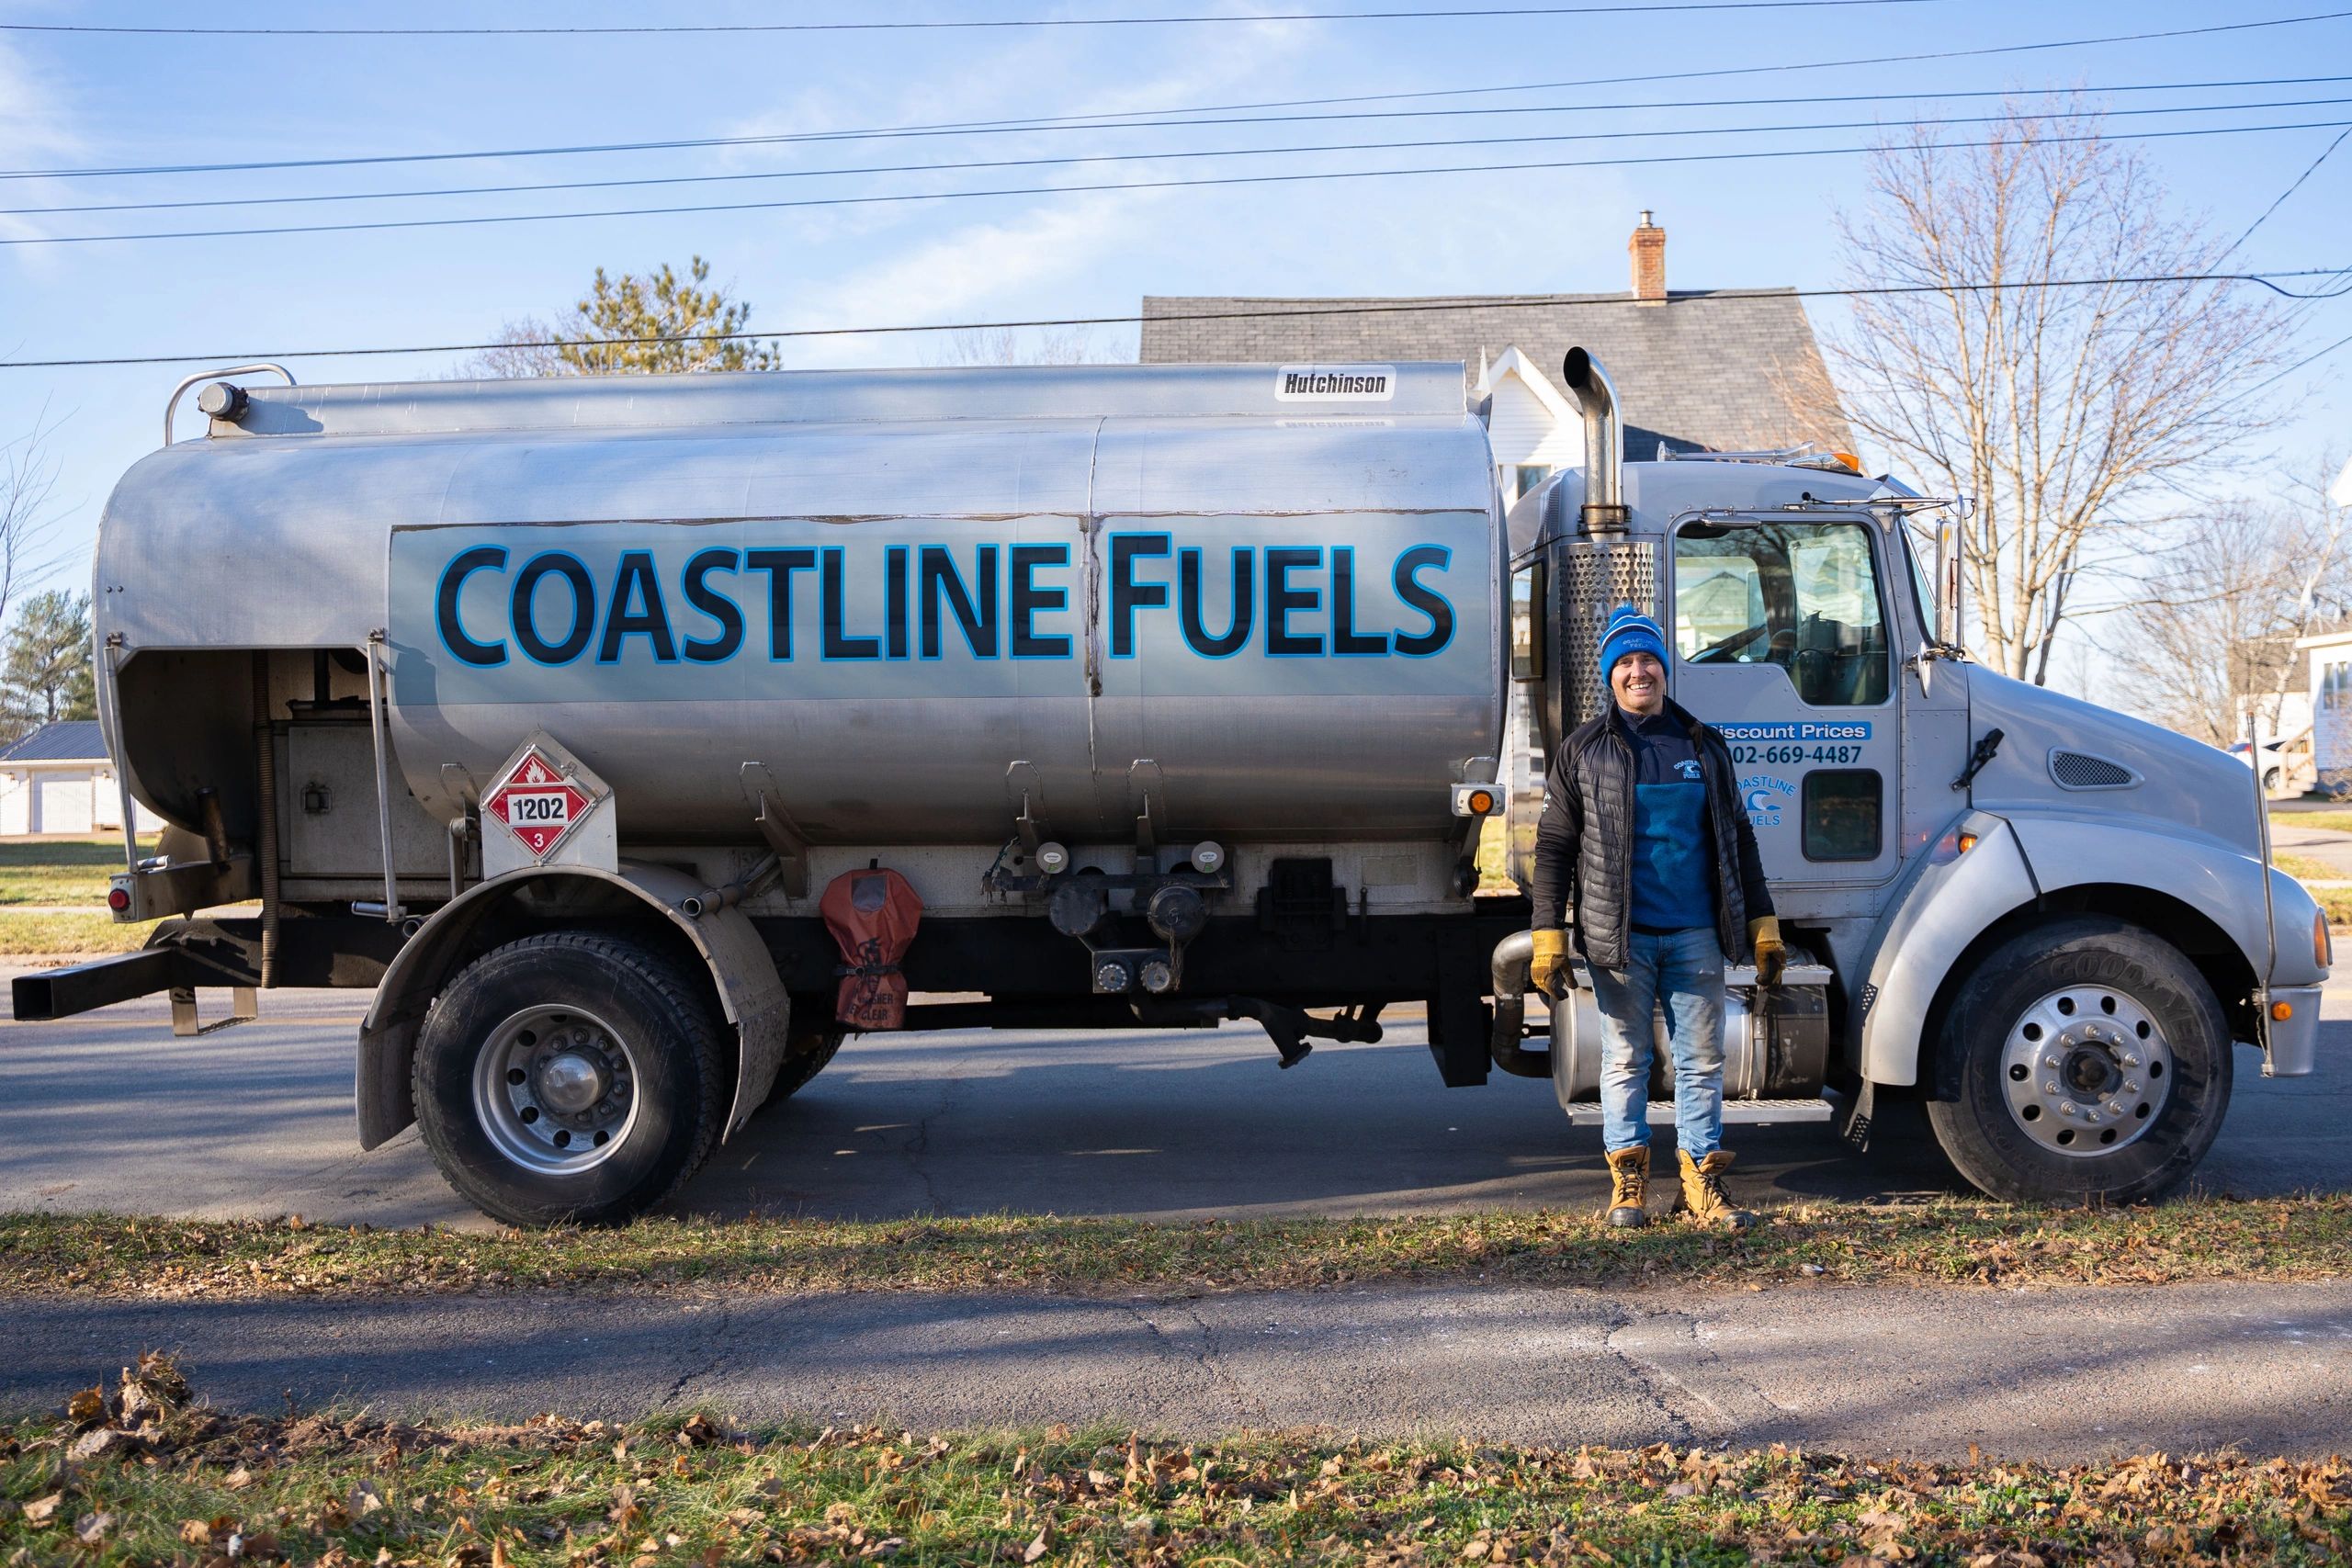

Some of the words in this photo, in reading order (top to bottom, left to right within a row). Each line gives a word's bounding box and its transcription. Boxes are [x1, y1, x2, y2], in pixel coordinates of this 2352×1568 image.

[1283, 373, 1386, 394] Hutchinson
[435, 542, 1073, 669] COASTLINE
[1108, 531, 1457, 660] FUELS
[1710, 725, 1795, 739] iscount
[1801, 724, 1866, 739] Prices
[1728, 746, 1862, 764] 02-669-4487
[1736, 775, 1796, 797] OASTLINE
[513, 797, 564, 820] 1202
[534, 832, 544, 848] 3
